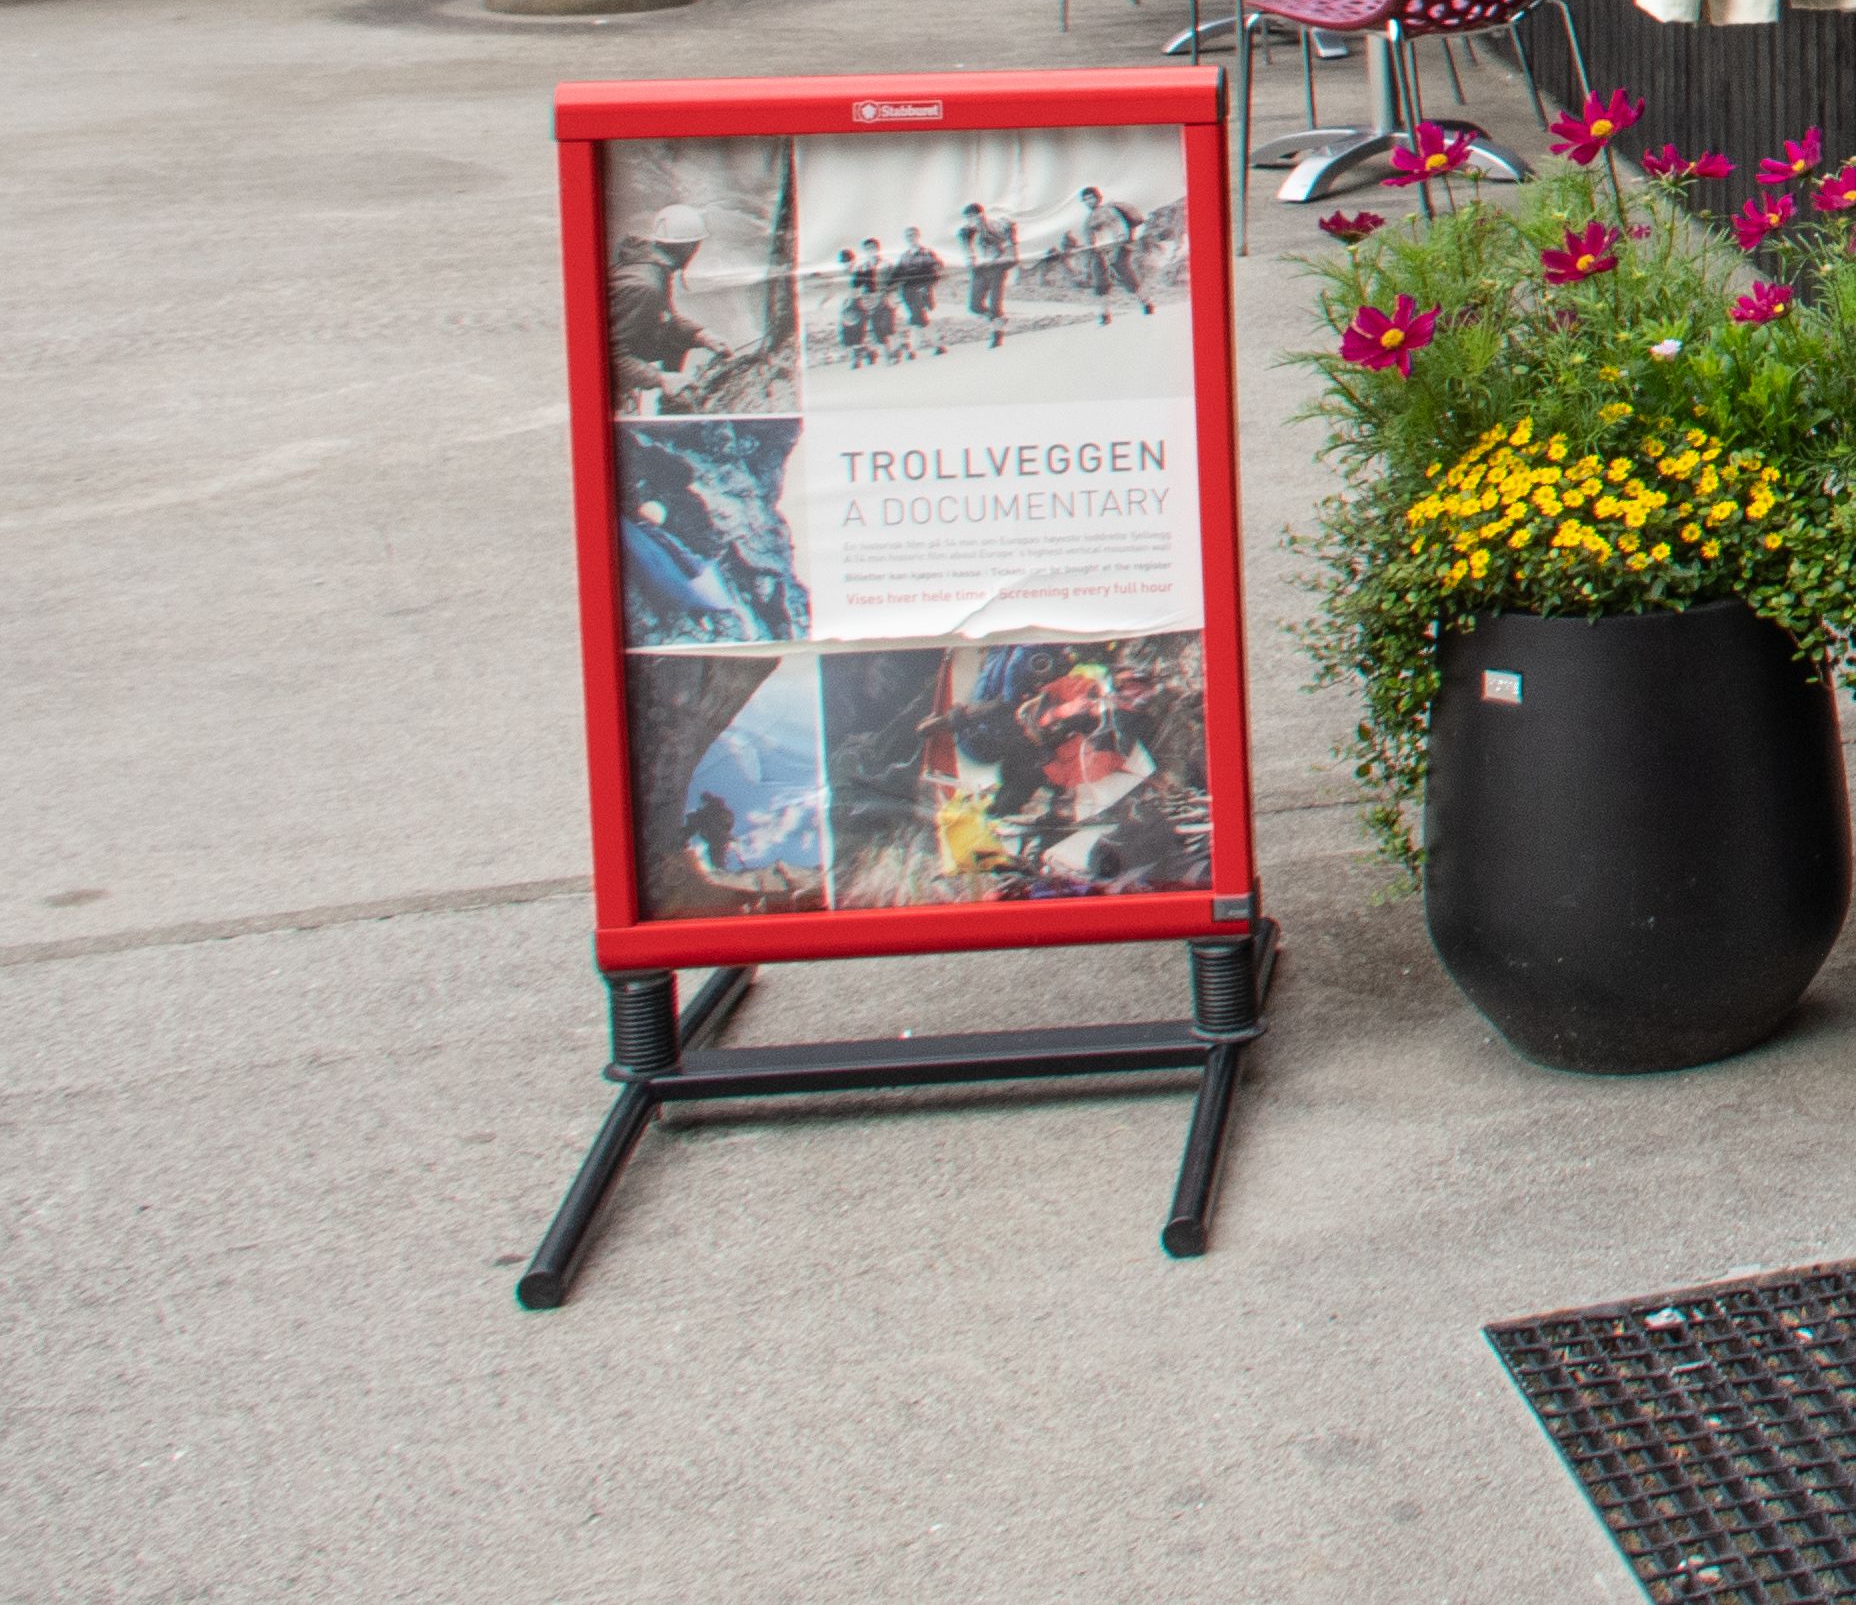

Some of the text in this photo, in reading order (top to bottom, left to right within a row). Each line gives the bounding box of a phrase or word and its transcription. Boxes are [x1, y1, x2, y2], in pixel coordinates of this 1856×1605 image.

[841, 440, 1168, 483] TROLLVEGGEN
[842, 487, 1170, 528] A DOCUMENTARY
[846, 591, 884, 605] Vises
[999, 584, 1070, 600] Screening
[1072, 582, 1111, 598] every
[1140, 580, 1175, 594] hour
